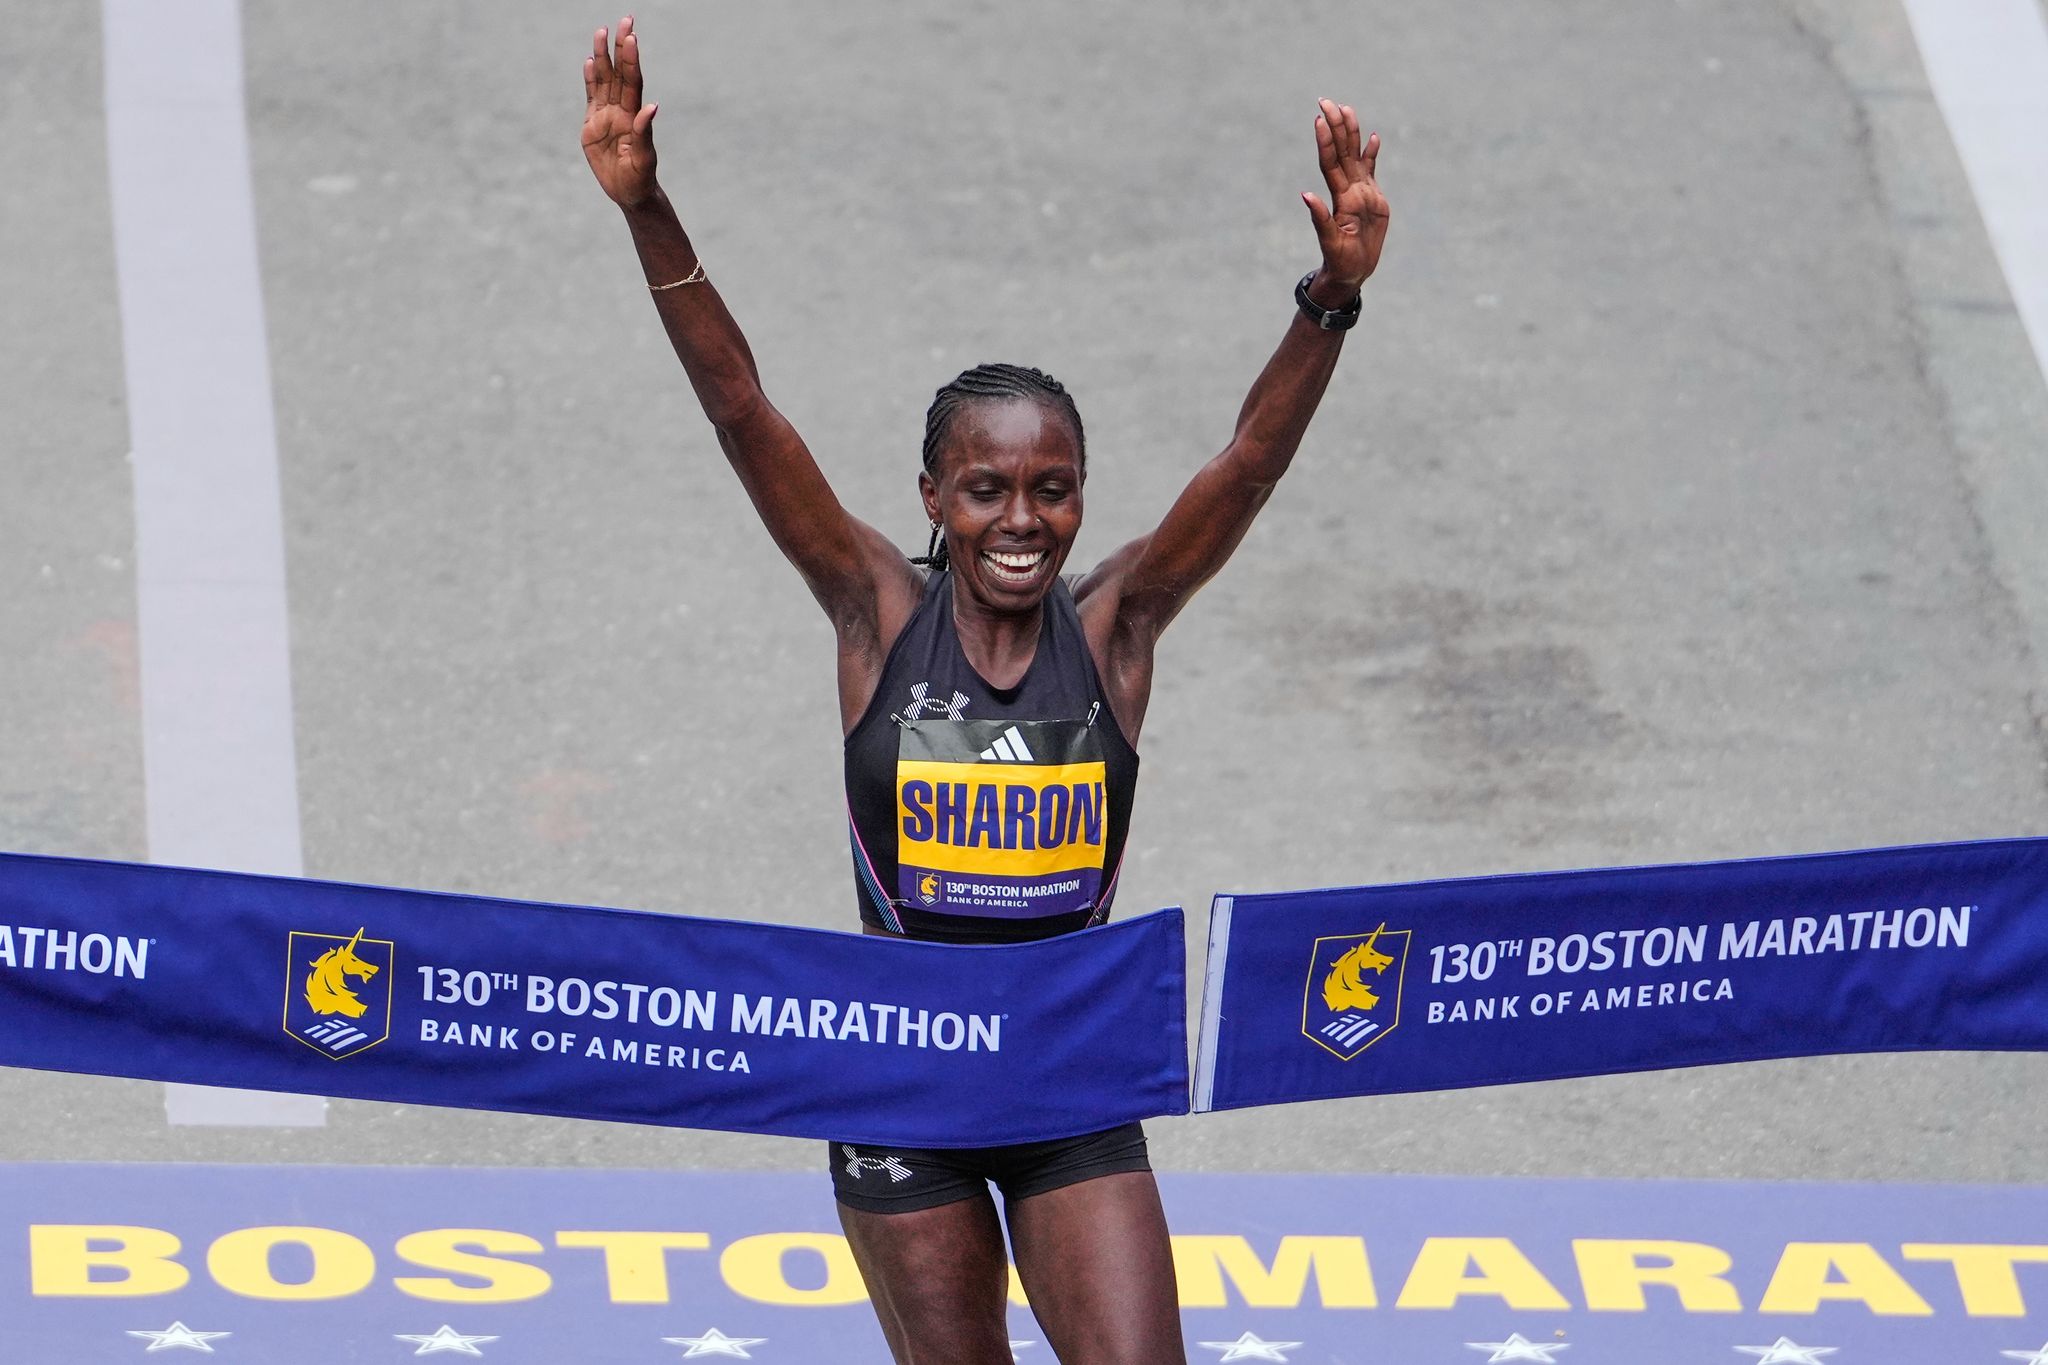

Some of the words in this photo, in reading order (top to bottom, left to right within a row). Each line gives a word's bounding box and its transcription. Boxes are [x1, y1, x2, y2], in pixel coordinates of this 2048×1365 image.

[901, 779, 1103, 850] SHARON
[946, 881, 971, 894] 130TH
[972, 884, 1020, 898] BOSTON
[1022, 879, 1080, 898] MARATHON
[946, 895, 972, 905] BANK
[987, 899, 1029, 908] AMERICA
[1428, 939, 1523, 984] 130TH
[1526, 924, 1708, 976] BOSTON
[1717, 906, 1971, 961] MARATHON
[417, 965, 518, 1007] 130TH
[525, 975, 717, 1031] BOSTON
[730, 993, 1001, 1052] MARATHON
[1426, 995, 1520, 1024] BANK
[1529, 990, 1573, 1017] OF
[1580, 978, 1735, 1013] AMERICA
[419, 1019, 520, 1051] BANK
[530, 1030, 577, 1055] OF
[583, 1036, 752, 1075] AMERICA
[28, 1224, 1030, 1306] BOSTO
